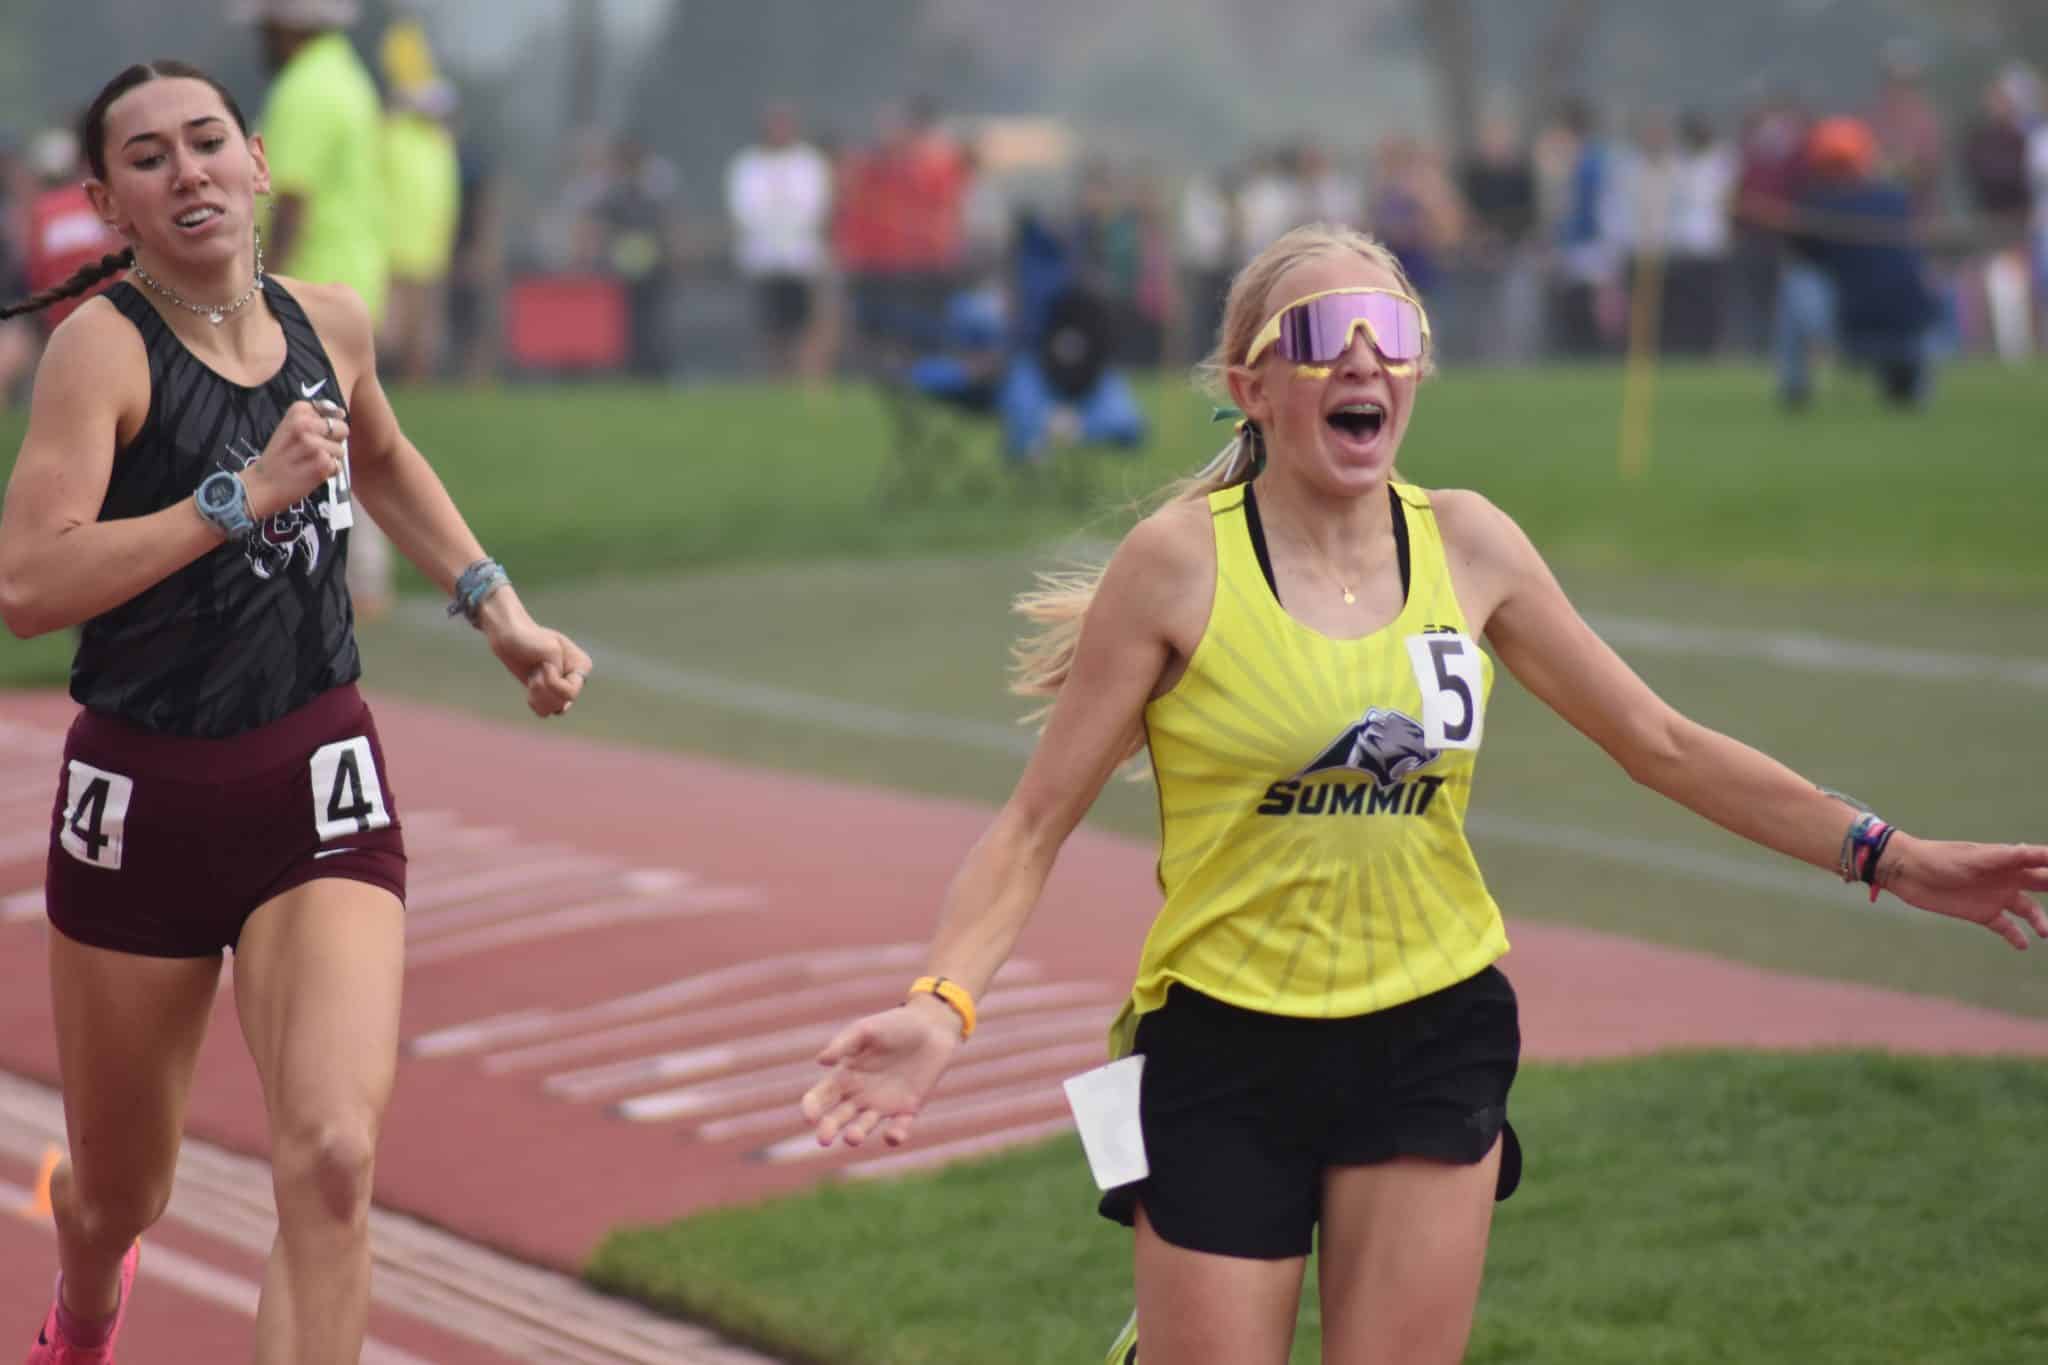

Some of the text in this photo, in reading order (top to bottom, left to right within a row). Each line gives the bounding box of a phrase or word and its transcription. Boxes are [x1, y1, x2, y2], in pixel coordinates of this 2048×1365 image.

[1427, 639, 1474, 742] 5
[69, 776, 111, 862] 4
[326, 747, 374, 832] 4
[1257, 774, 1448, 816] SUMMIT
